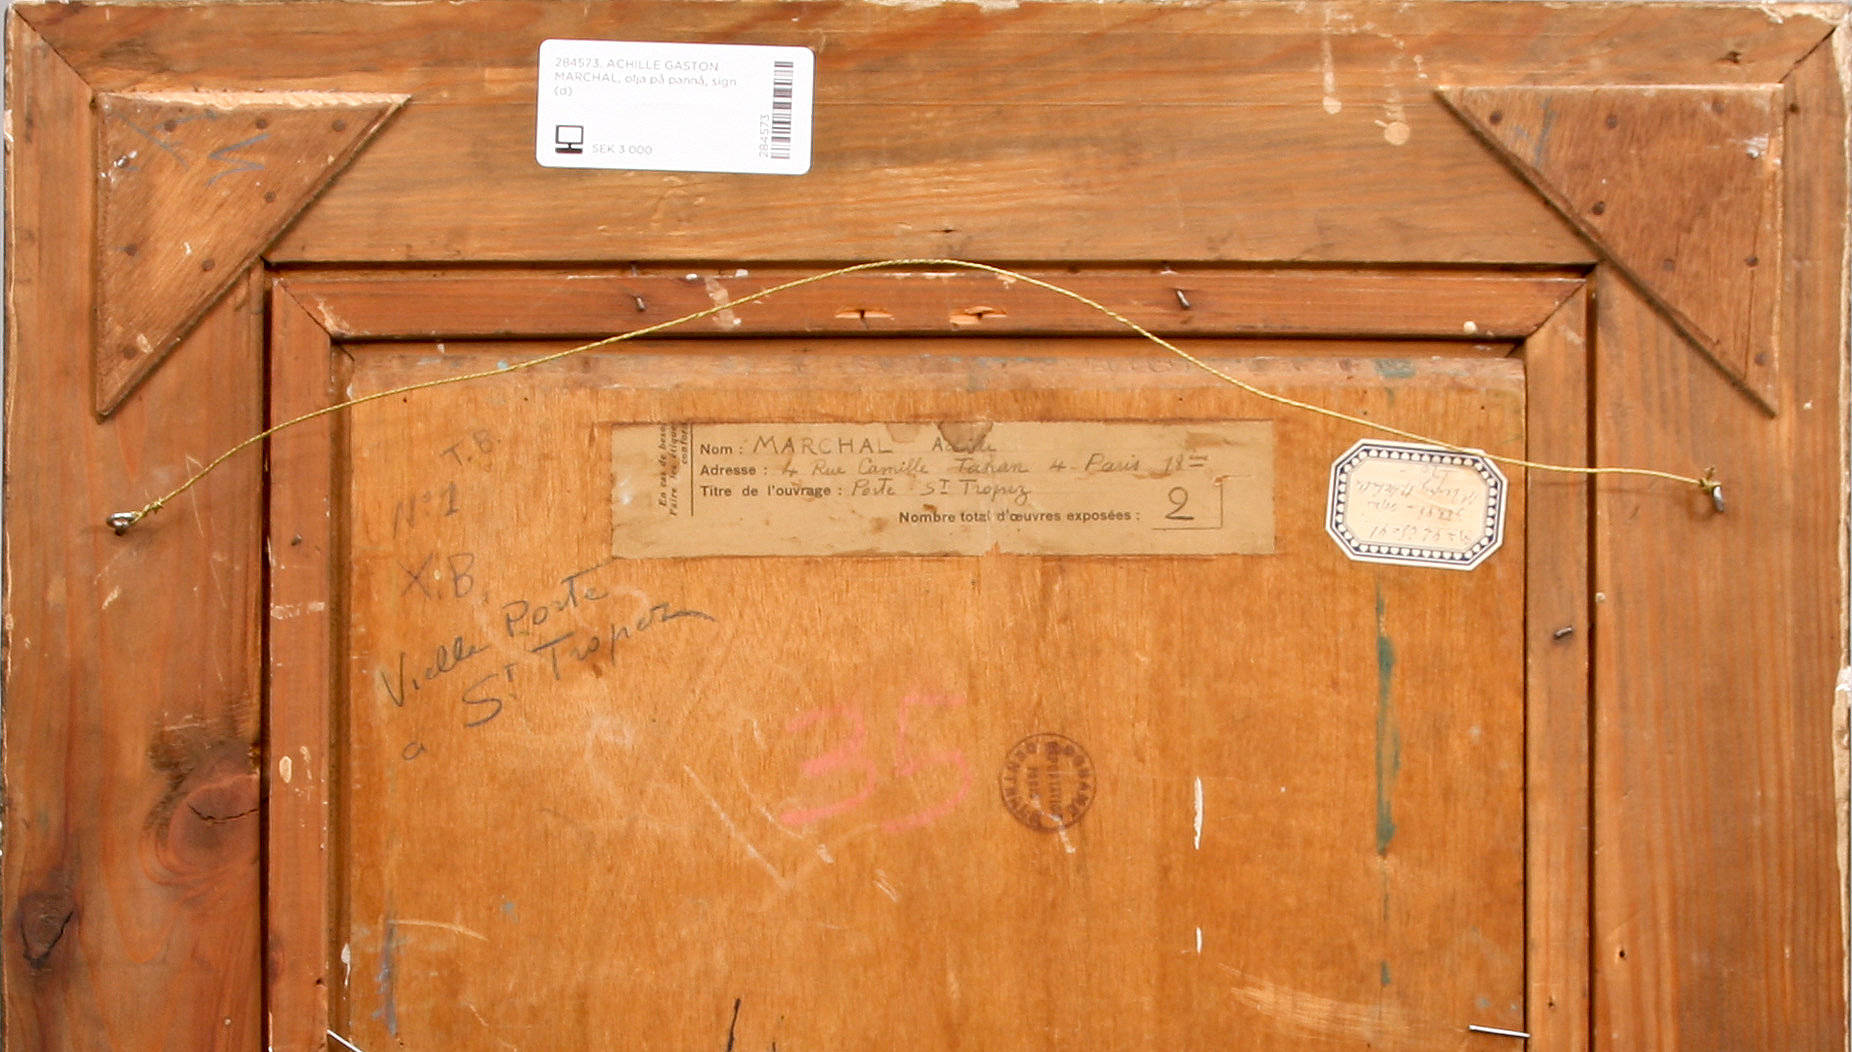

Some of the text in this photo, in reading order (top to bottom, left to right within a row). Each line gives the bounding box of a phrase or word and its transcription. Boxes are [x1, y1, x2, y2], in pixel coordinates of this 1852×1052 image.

[606, 58, 661, 70] ACHILLE
[664, 60, 719, 72] GASTON
[554, 72, 622, 84] MARCHAL,
[624, 74, 647, 85] olja
[650, 74, 665, 85] på
[554, 85, 573, 97] (d)
[758, 114, 770, 158] 284573
[592, 144, 653, 155] SEK 3 000
[700, 444, 733, 455] Nom
[753, 435, 893, 456] MARCHAL
[657, 424, 667, 507] En cas de beso
[700, 464, 757, 476] Adresse
[811, 458, 846, 476] Rue
[858, 457, 929, 475] Camille
[1085, 453, 1140, 473] Paris
[701, 484, 732, 498] Titre
[742, 484, 759, 497] de
[767, 484, 832, 498] l'ouvrage
[851, 478, 896, 497] Porte
[958, 479, 1032, 506] Tropez
[899, 511, 956, 523] Nombre
[960, 510, 991, 522] total
[997, 510, 1061, 522] d'œuvres
[1067, 510, 1131, 525] exposées
[1165, 486, 1195, 521] 2
[502, 556, 619, 636] Porte
